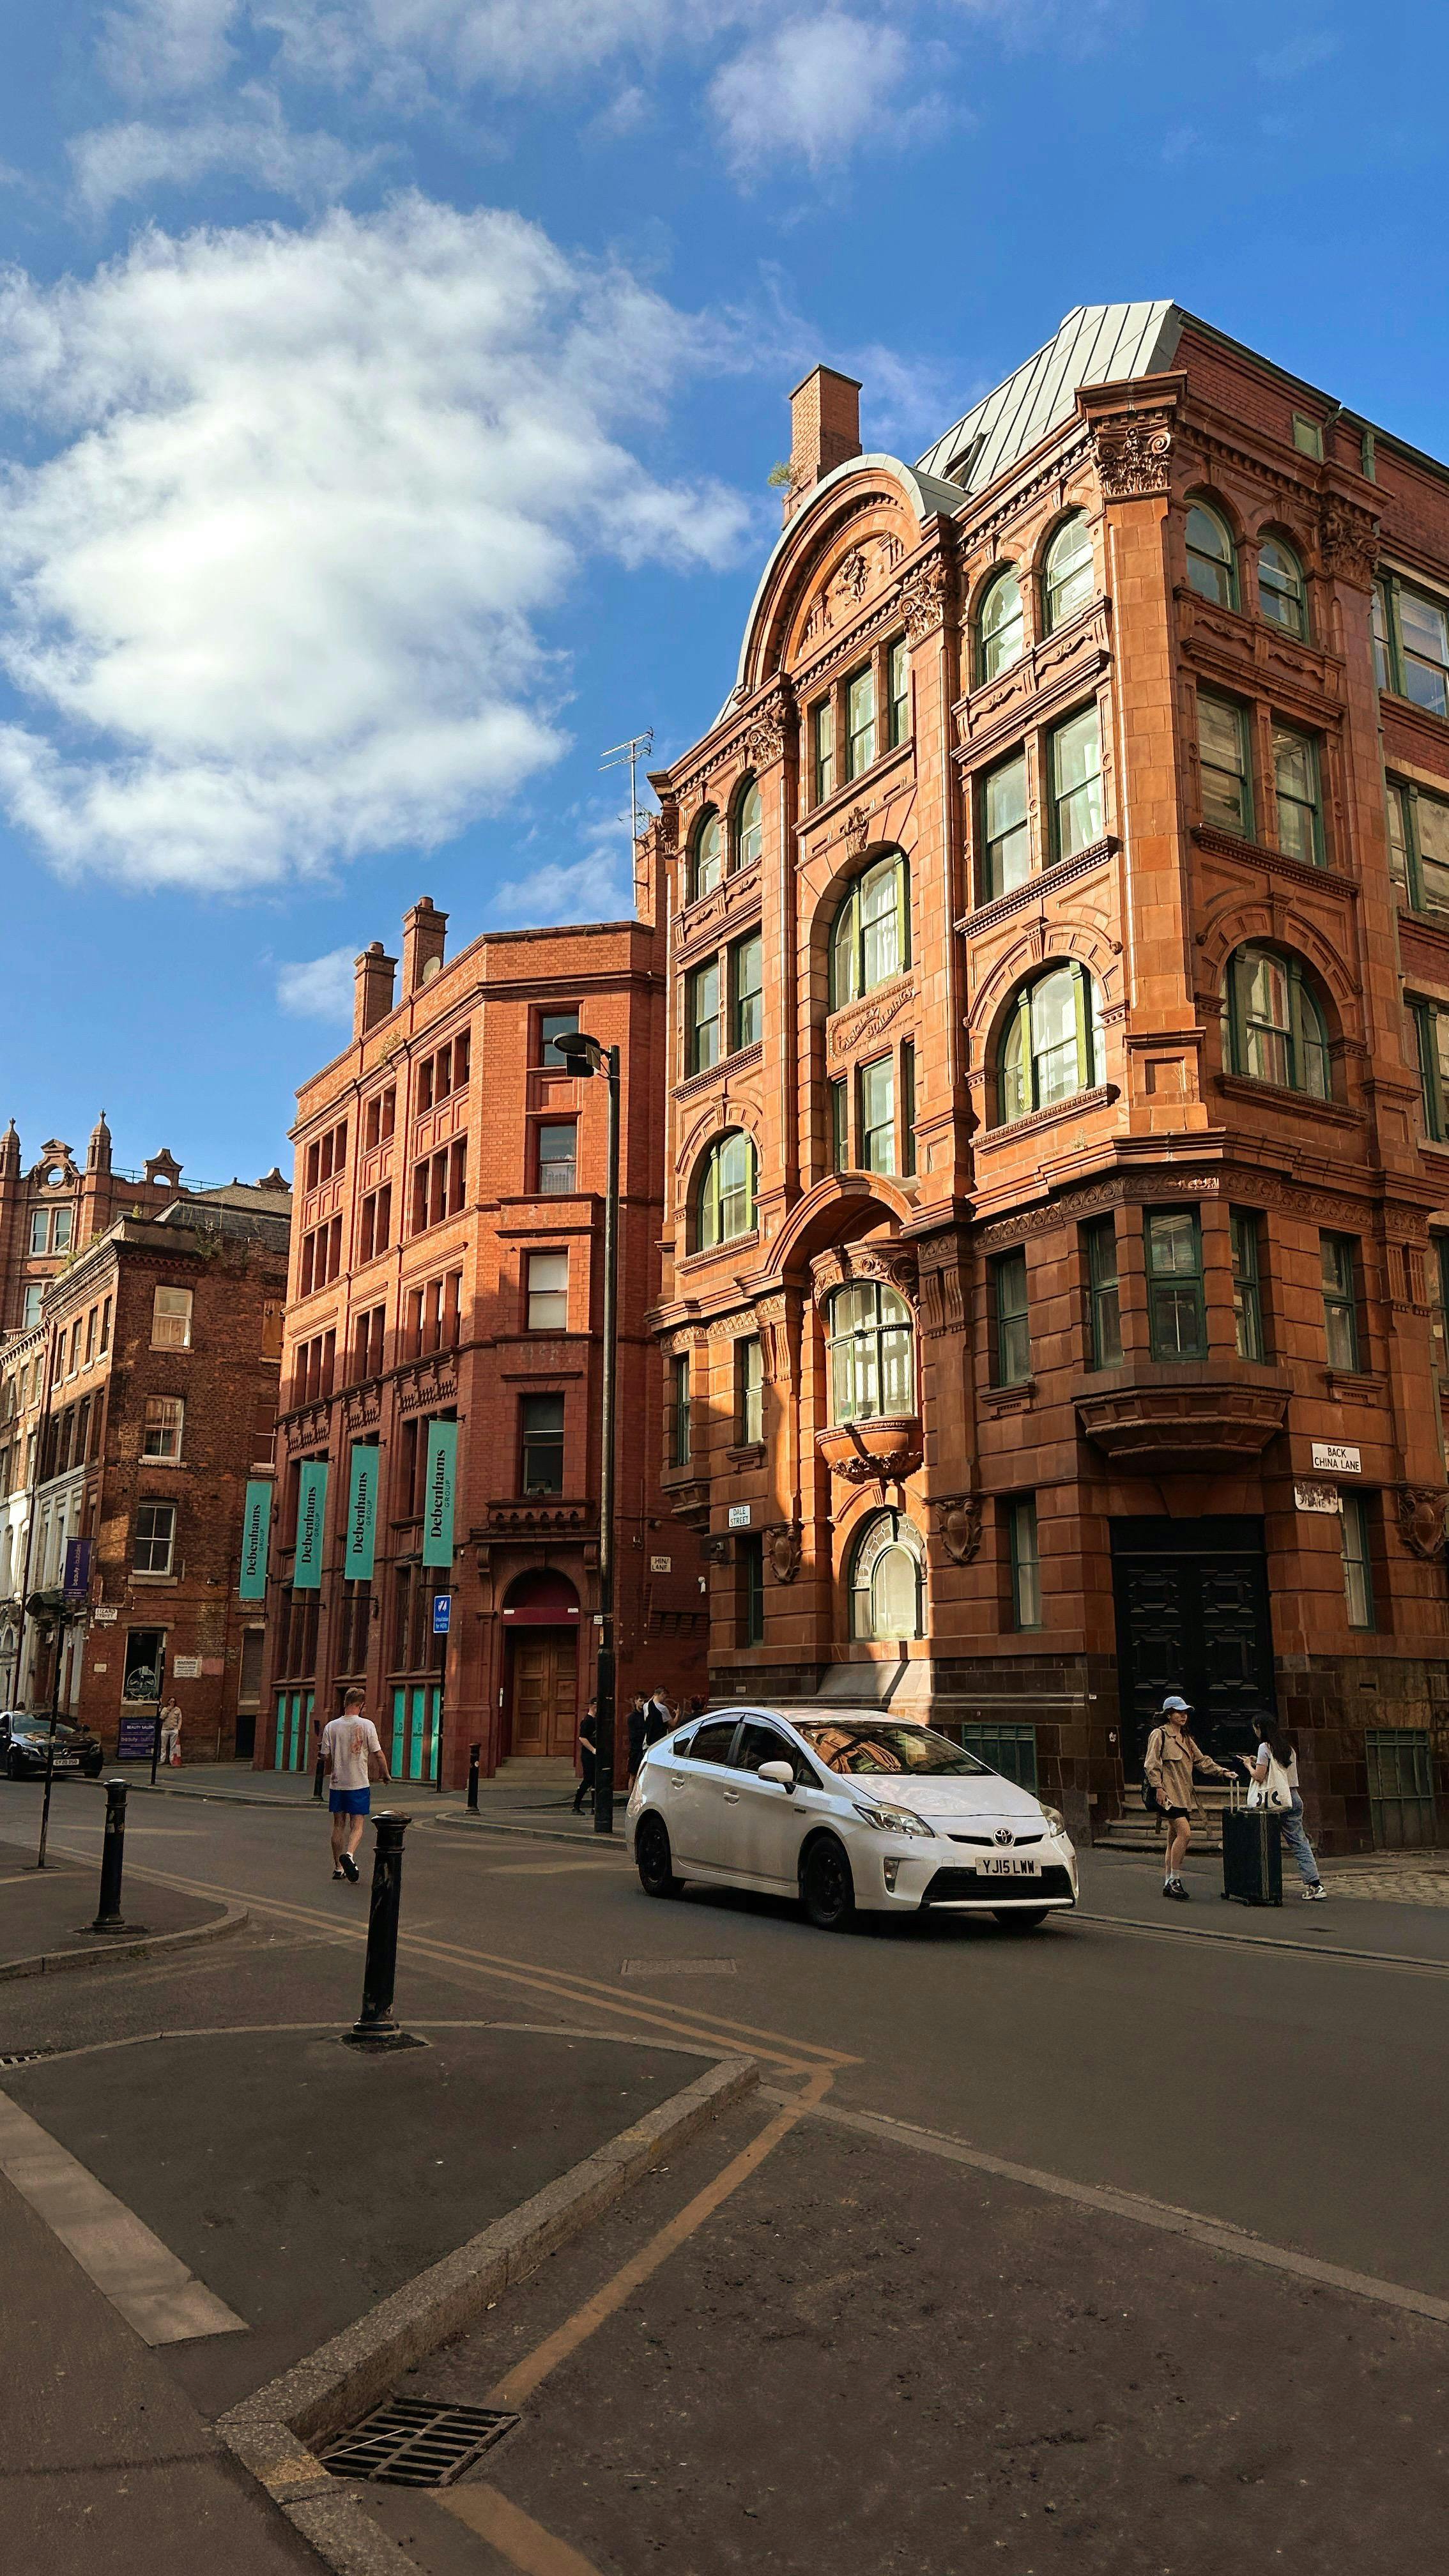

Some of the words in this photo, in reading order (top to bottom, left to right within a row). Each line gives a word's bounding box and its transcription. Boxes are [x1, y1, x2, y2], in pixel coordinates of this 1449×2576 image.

[1327, 1446, 1347, 1459] BACK
[1314, 1457, 1338, 1468] CHINA
[1340, 1459, 1360, 1471] LANE
[431, 1449, 446, 1538] Debenhams
[353, 1471, 368, 1553] Debenhams
[733, 1506, 746, 1517] DALE
[302, 1486, 316, 1563] Debenhams
[730, 1515, 749, 1526] STREET
[247, 1504, 261, 1575] Debenhams
[983, 1859, 1010, 1874] YJ15
[1013, 1860, 1034, 1874] LWW
